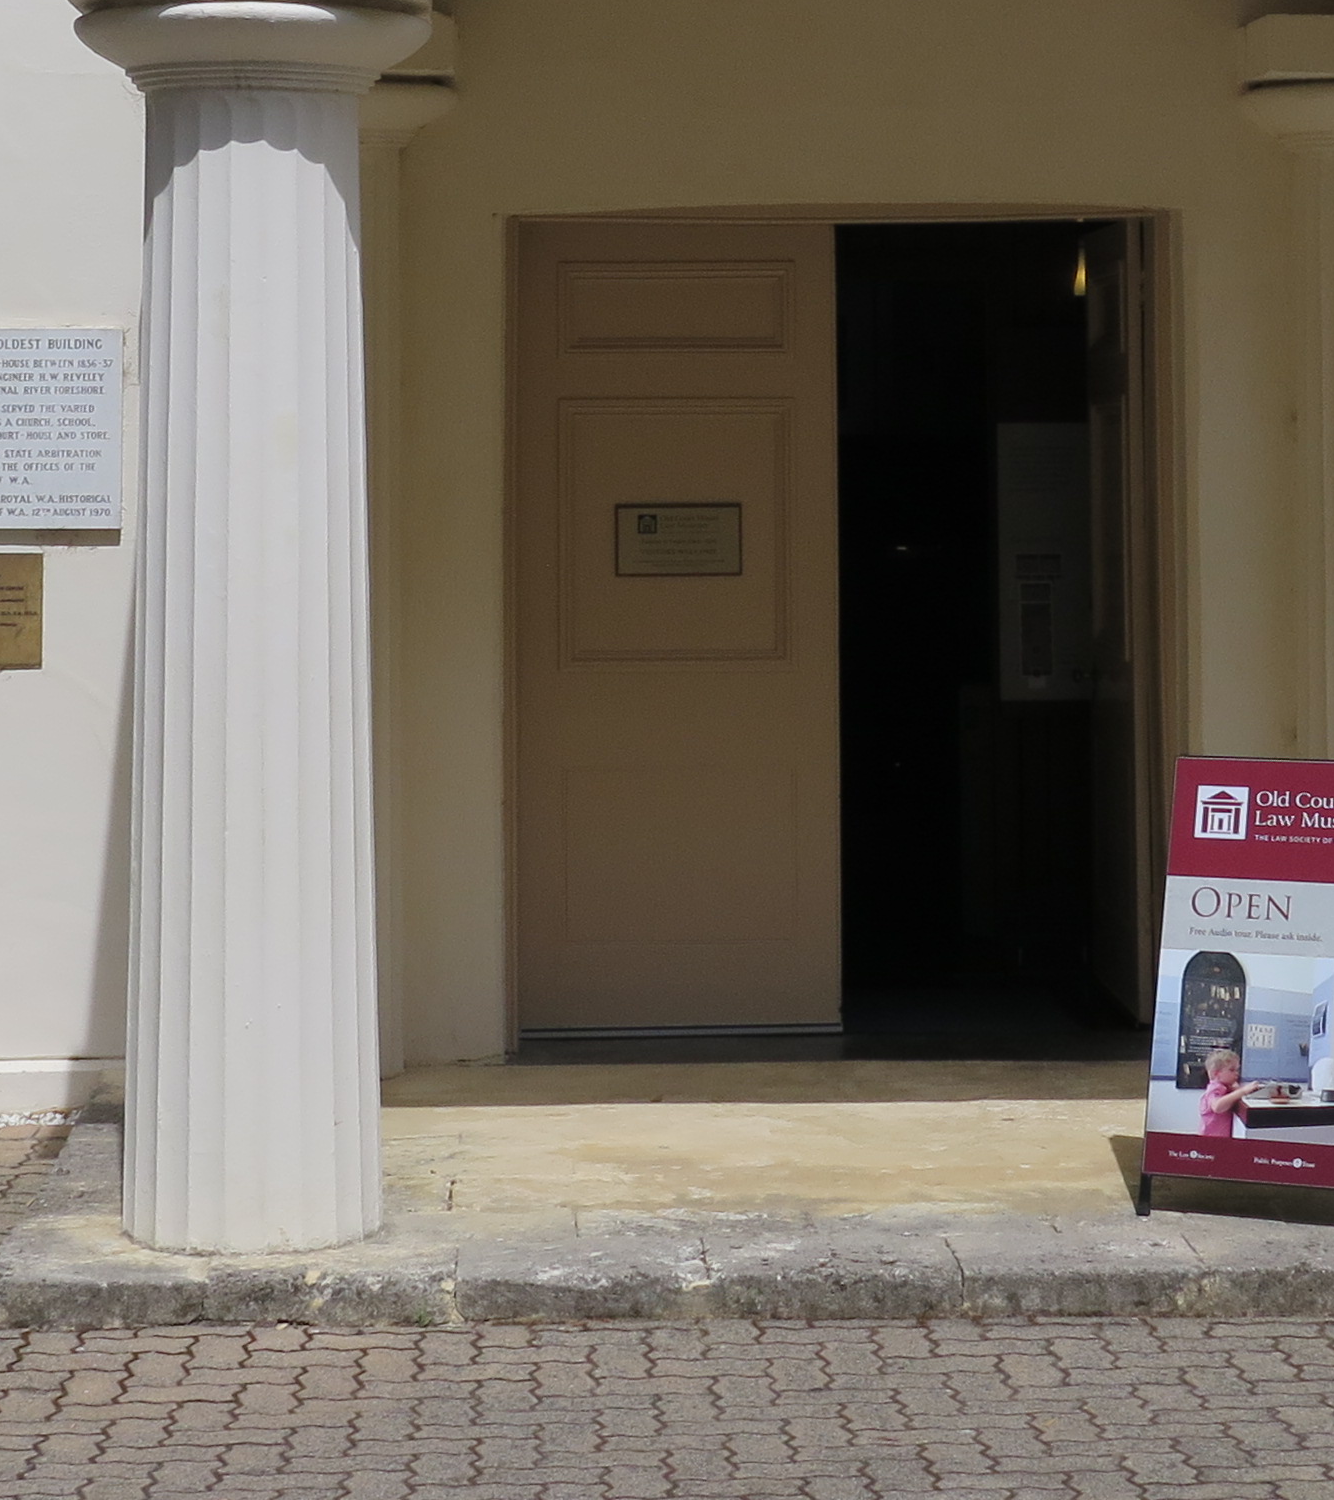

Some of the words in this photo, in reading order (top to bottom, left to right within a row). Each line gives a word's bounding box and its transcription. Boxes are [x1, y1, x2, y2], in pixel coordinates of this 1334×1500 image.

[47, 338, 103, 350] BUILDING
[33, 358, 74, 368] BETWEEN
[63, 372, 105, 382] REVELEY
[23, 386, 51, 394] RIVER
[1, 404, 35, 413] SERVED
[40, 404, 56, 413] THE
[61, 404, 95, 413] VARIED
[5, 418, 13, 426] A
[57, 432, 76, 440] AND
[4, 450, 31, 458] STATE
[37, 450, 102, 458] ARBITRATION
[2, 462, 18, 472] THE
[23, 462, 59, 472] OFFICES
[64, 462, 75, 472] OF
[80, 462, 96, 472] THE
[9, 476, 33, 484] W.A.
[1, 494, 32, 503] ROYAL
[59, 494, 111, 503] HISTORICAL
[53, 508, 87, 516] AUGUST
[1256, 790, 1289, 808] Old
[1255, 810, 1295, 826] Law
[1255, 834, 1269, 842] THE
[1289, 836, 1320, 844] SOCIETY
[1191, 886, 1292, 922] OPEN
[1189, 926, 1207, 936] Free
[1208, 928, 1232, 936] Audio
[1255, 931, 1279, 940] Please
[1281, 932, 1295, 940] ask
[1297, 933, 1323, 942] inside.
